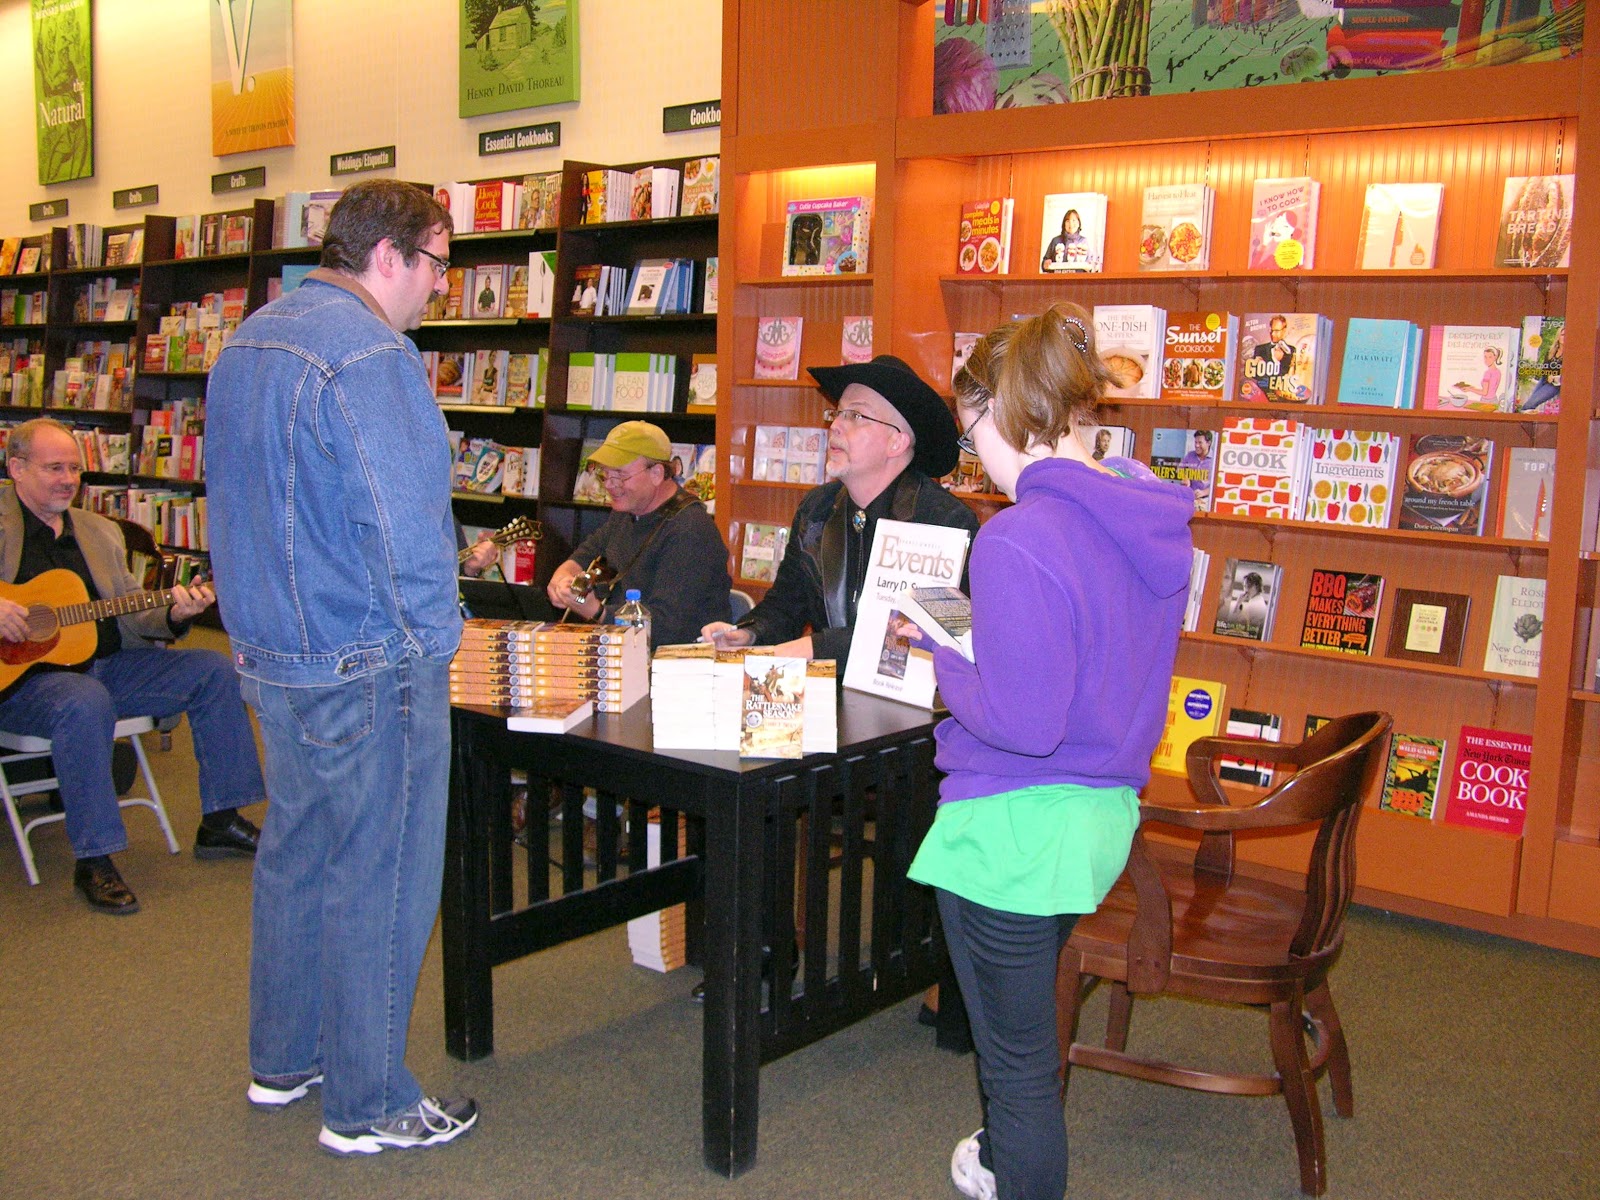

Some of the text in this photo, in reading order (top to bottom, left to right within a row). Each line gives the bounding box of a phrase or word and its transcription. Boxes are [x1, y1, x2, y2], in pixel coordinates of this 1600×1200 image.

[73, 78, 85, 93] the
[466, 76, 565, 101] HENRY DAVID THOREAU
[39, 93, 86, 129] Natural
[485, 128, 554, 152] Essential Cookbooks
[336, 151, 389, 171] Weddings/Etiquette
[1147, 191, 1172, 201] Harvest
[1264, 192, 1285, 204] KNOW
[1287, 186, 1306, 198] HOW
[475, 198, 498, 210] Cook
[799, 202, 811, 210] Cutie
[812, 201, 833, 210] Cupcake
[1267, 196, 1301, 212] TO COOK
[972, 214, 1000, 226] meals in
[1508, 209, 1573, 222] TARTINE
[971, 225, 999, 236] minutes
[1507, 221, 1557, 235] BREAD
[1096, 321, 1148, 332] ONE-DISH
[1189, 323, 1201, 331] THE
[1165, 326, 1228, 345] Sunset
[1448, 331, 1505, 340] DECEPTIVELY
[1174, 344, 1215, 353] COOKBOOK
[1447, 340, 1491, 349] DELICIOUS
[1244, 358, 1281, 378] GOOD
[616, 375, 645, 387] CLEAN
[1269, 375, 1300, 393] EATS
[616, 386, 644, 399] FOOD
[1222, 450, 1288, 470] COOK
[1523, 462, 1546, 472] TOP
[1150, 465, 1210, 481] TYLER'S ULTIMATE
[1315, 462, 1385, 479] Ingredients
[1405, 496, 1426, 505] around
[1438, 497, 1459, 506] french
[1459, 498, 1476, 507] table
[876, 534, 955, 580] Events
[877, 576, 899, 592] Larry
[1311, 571, 1347, 599] BBQ
[1308, 596, 1344, 614] MAKES
[1305, 612, 1367, 633] EVERYTHING
[1302, 626, 1341, 646] BETTER
[1491, 642, 1510, 653] New
[745, 699, 803, 712] RATTLESNAKE
[750, 694, 765, 702] THE
[763, 709, 795, 719] SEASON
[1398, 744, 1417, 753] WILD
[1466, 735, 1533, 753] THE ESSENTIAL
[1463, 748, 1530, 767] New York Times
[1459, 760, 1530, 789] COOK
[1456, 781, 1526, 811] BOOK
